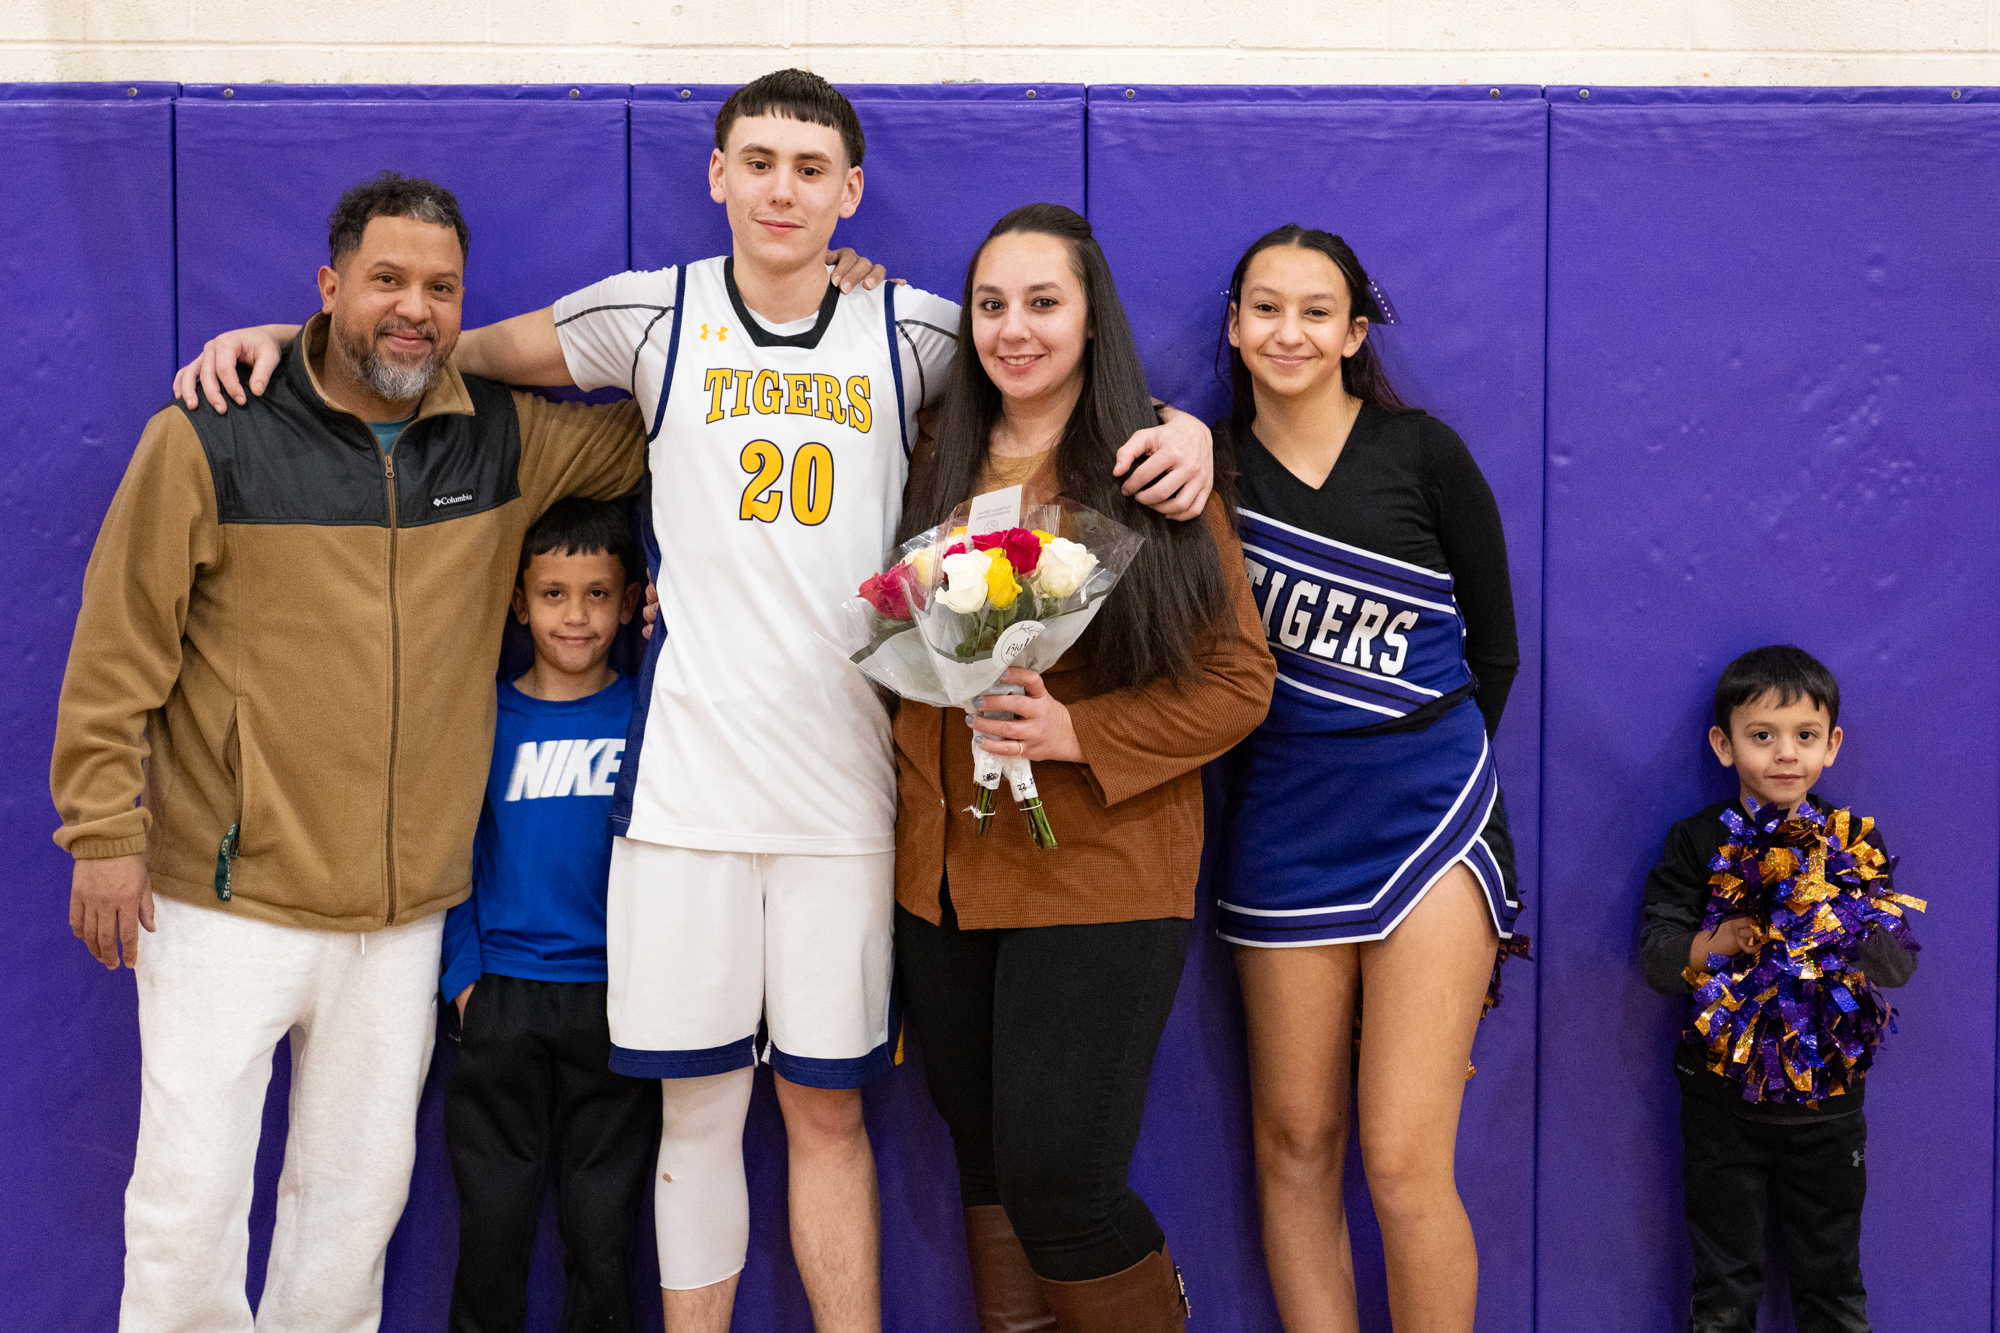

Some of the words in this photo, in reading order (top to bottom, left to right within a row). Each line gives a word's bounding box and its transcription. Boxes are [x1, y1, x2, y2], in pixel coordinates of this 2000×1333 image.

[704, 368, 872, 433] TIGERS
[441, 493, 472, 505] Columbia
[739, 439, 834, 526] 20
[504, 738, 626, 801] NIKE
